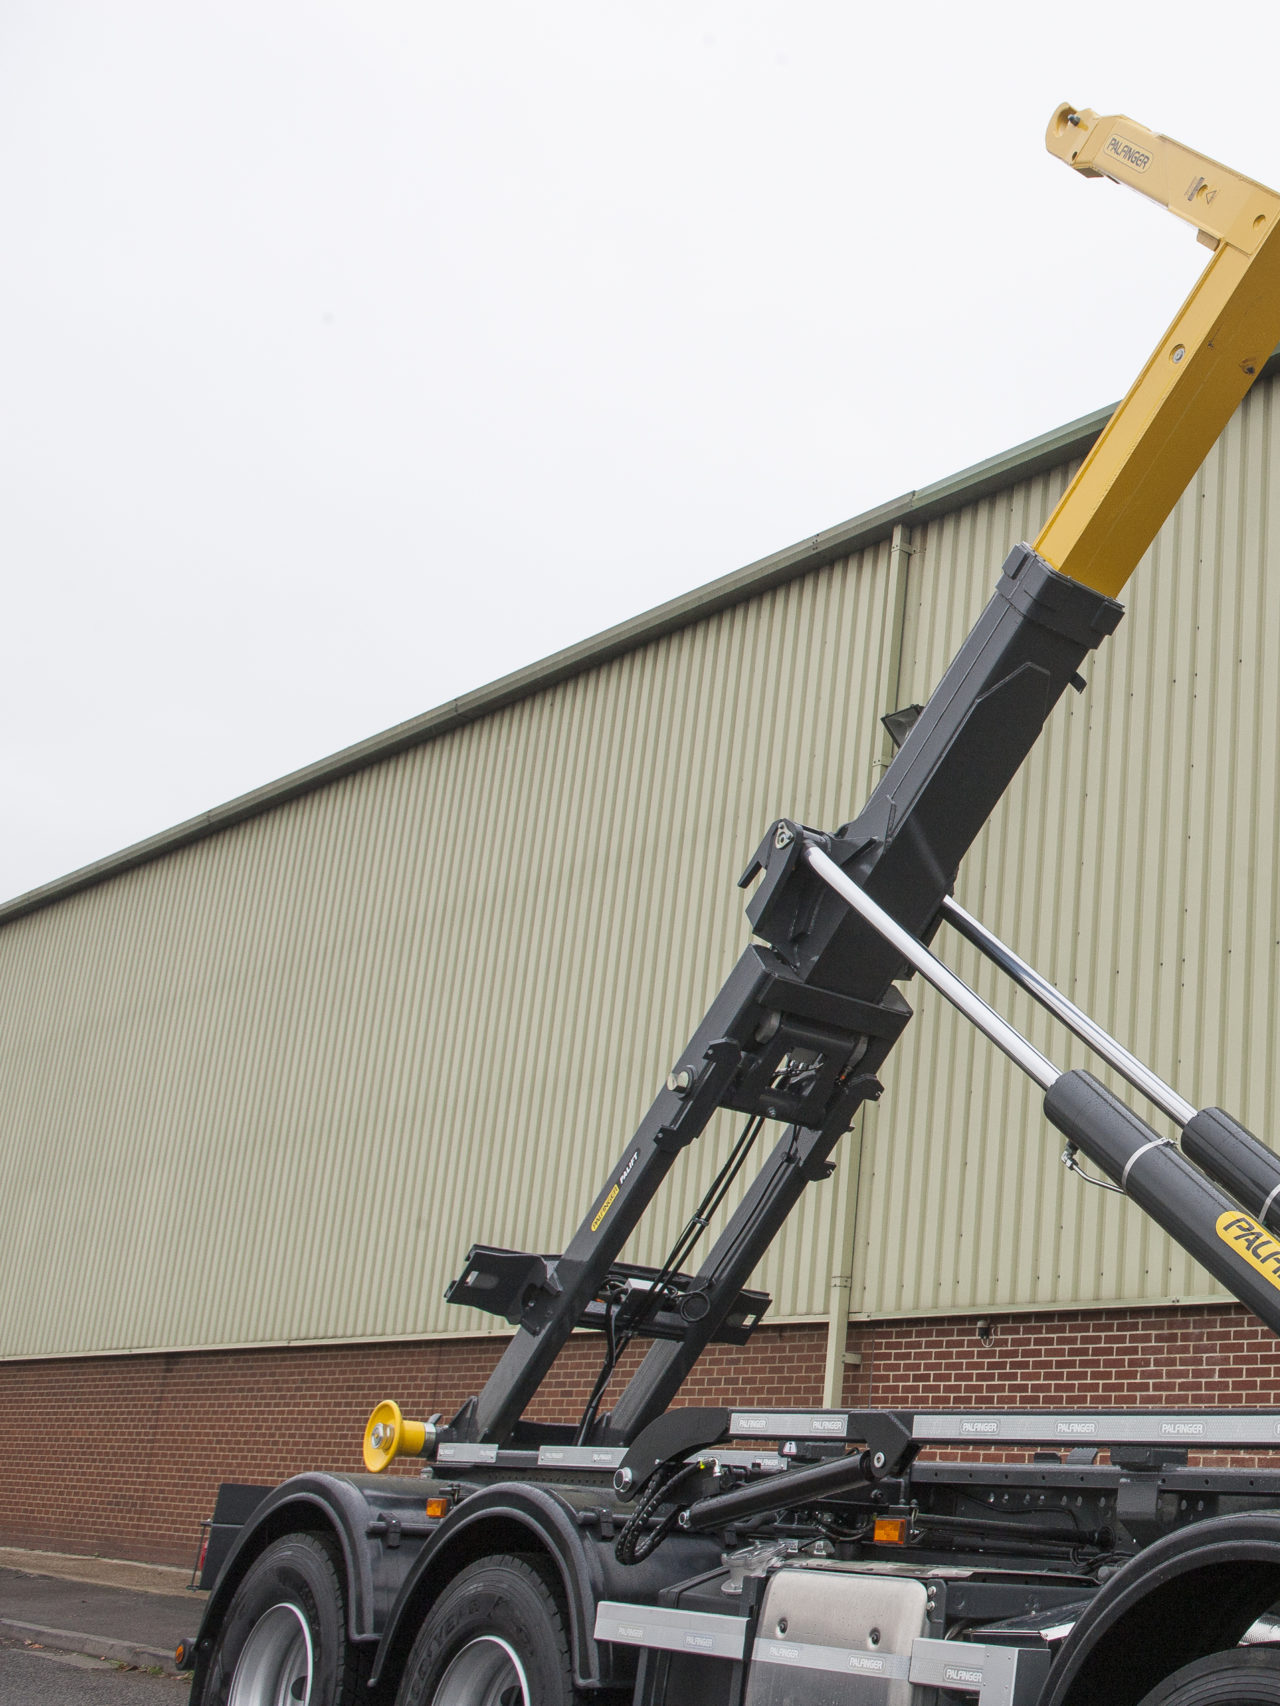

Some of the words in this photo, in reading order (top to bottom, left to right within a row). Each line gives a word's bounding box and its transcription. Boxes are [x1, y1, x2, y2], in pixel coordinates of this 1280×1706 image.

[1106, 137, 1150, 170] PALFINGER
[619, 1151, 638, 1185] PALIFT
[738, 1419, 767, 1429] PALFINGER
[811, 1421, 842, 1430] PALFINGER
[961, 1422, 998, 1432] PALFINGER
[1056, 1423, 1096, 1433] PALFINGER
[1161, 1423, 1204, 1434] PALFINGER
[769, 1646, 800, 1659] PALFINGER
[849, 1656, 884, 1670] PALFINGER
[946, 1669, 983, 1683] PALFINGER
